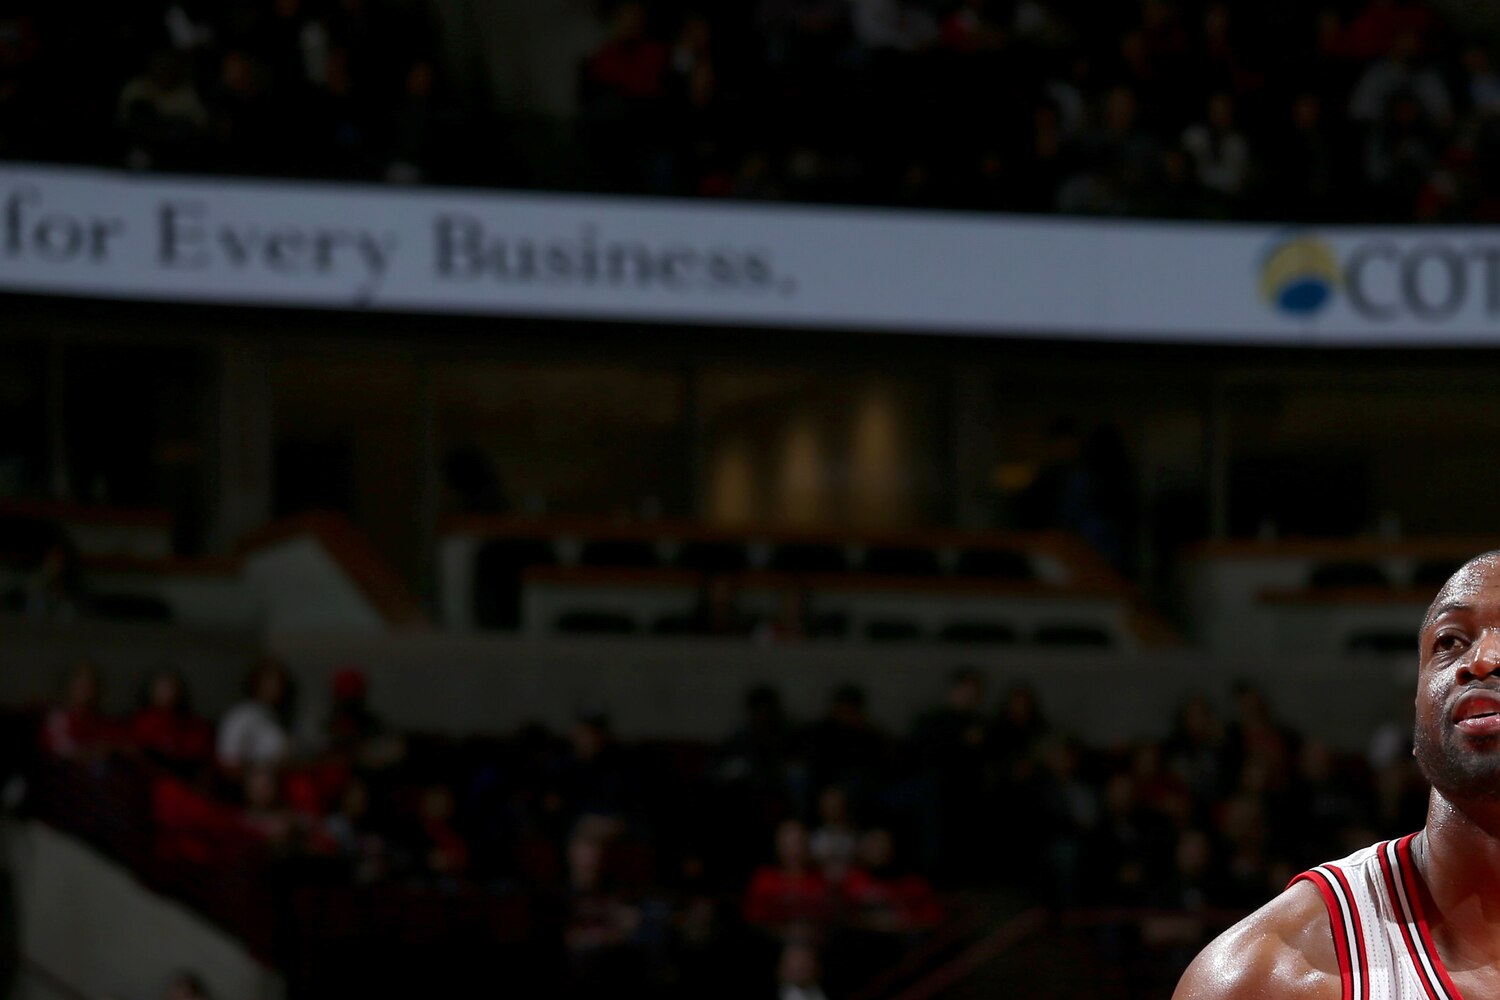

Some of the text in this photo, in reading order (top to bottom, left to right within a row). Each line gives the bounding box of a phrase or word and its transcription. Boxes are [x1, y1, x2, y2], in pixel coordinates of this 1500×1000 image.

[2, 184, 798, 306] for Every Business.
